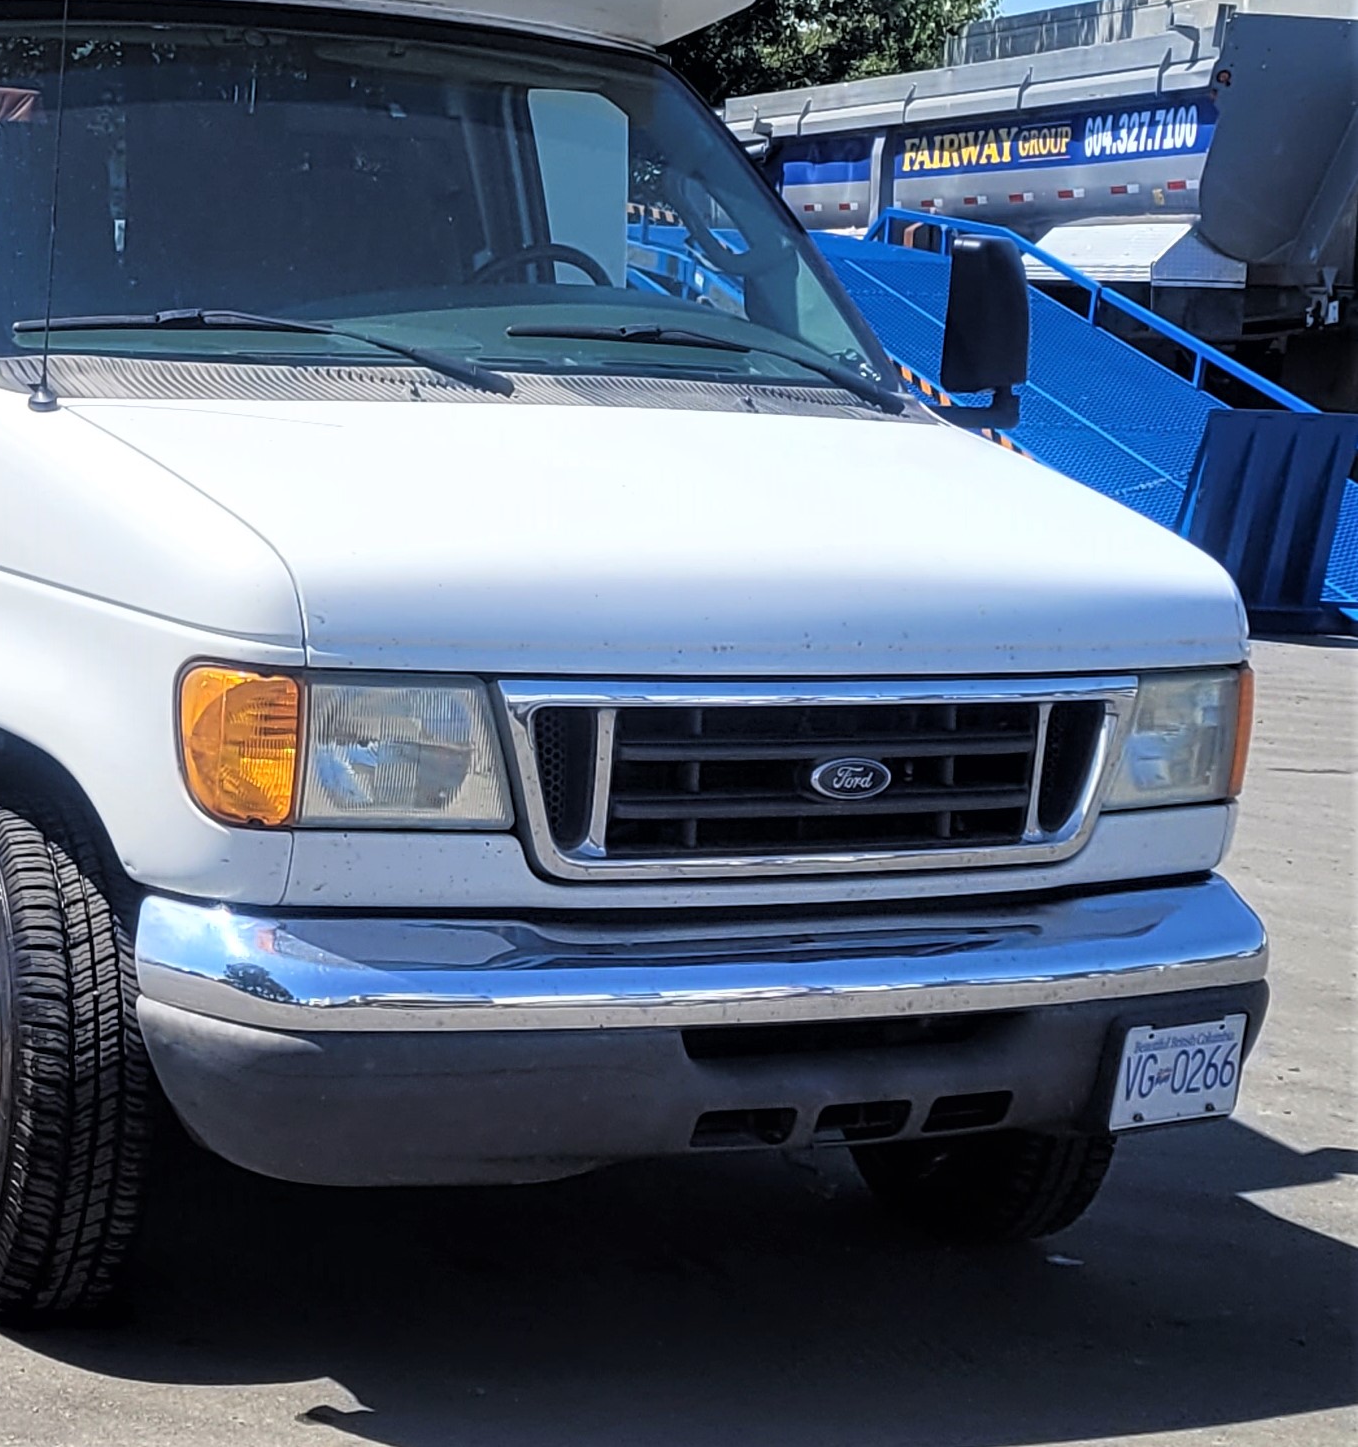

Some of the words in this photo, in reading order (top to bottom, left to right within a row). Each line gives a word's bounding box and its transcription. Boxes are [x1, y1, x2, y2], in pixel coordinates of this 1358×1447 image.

[901, 126, 1019, 171] FAIRWAY
[1018, 126, 1073, 157] GROUP
[1084, 105, 1199, 158] 604.327.7100
[832, 766, 874, 789] Ford
[1125, 1054, 1159, 1102] VG
[1170, 1042, 1239, 1095] 0266
